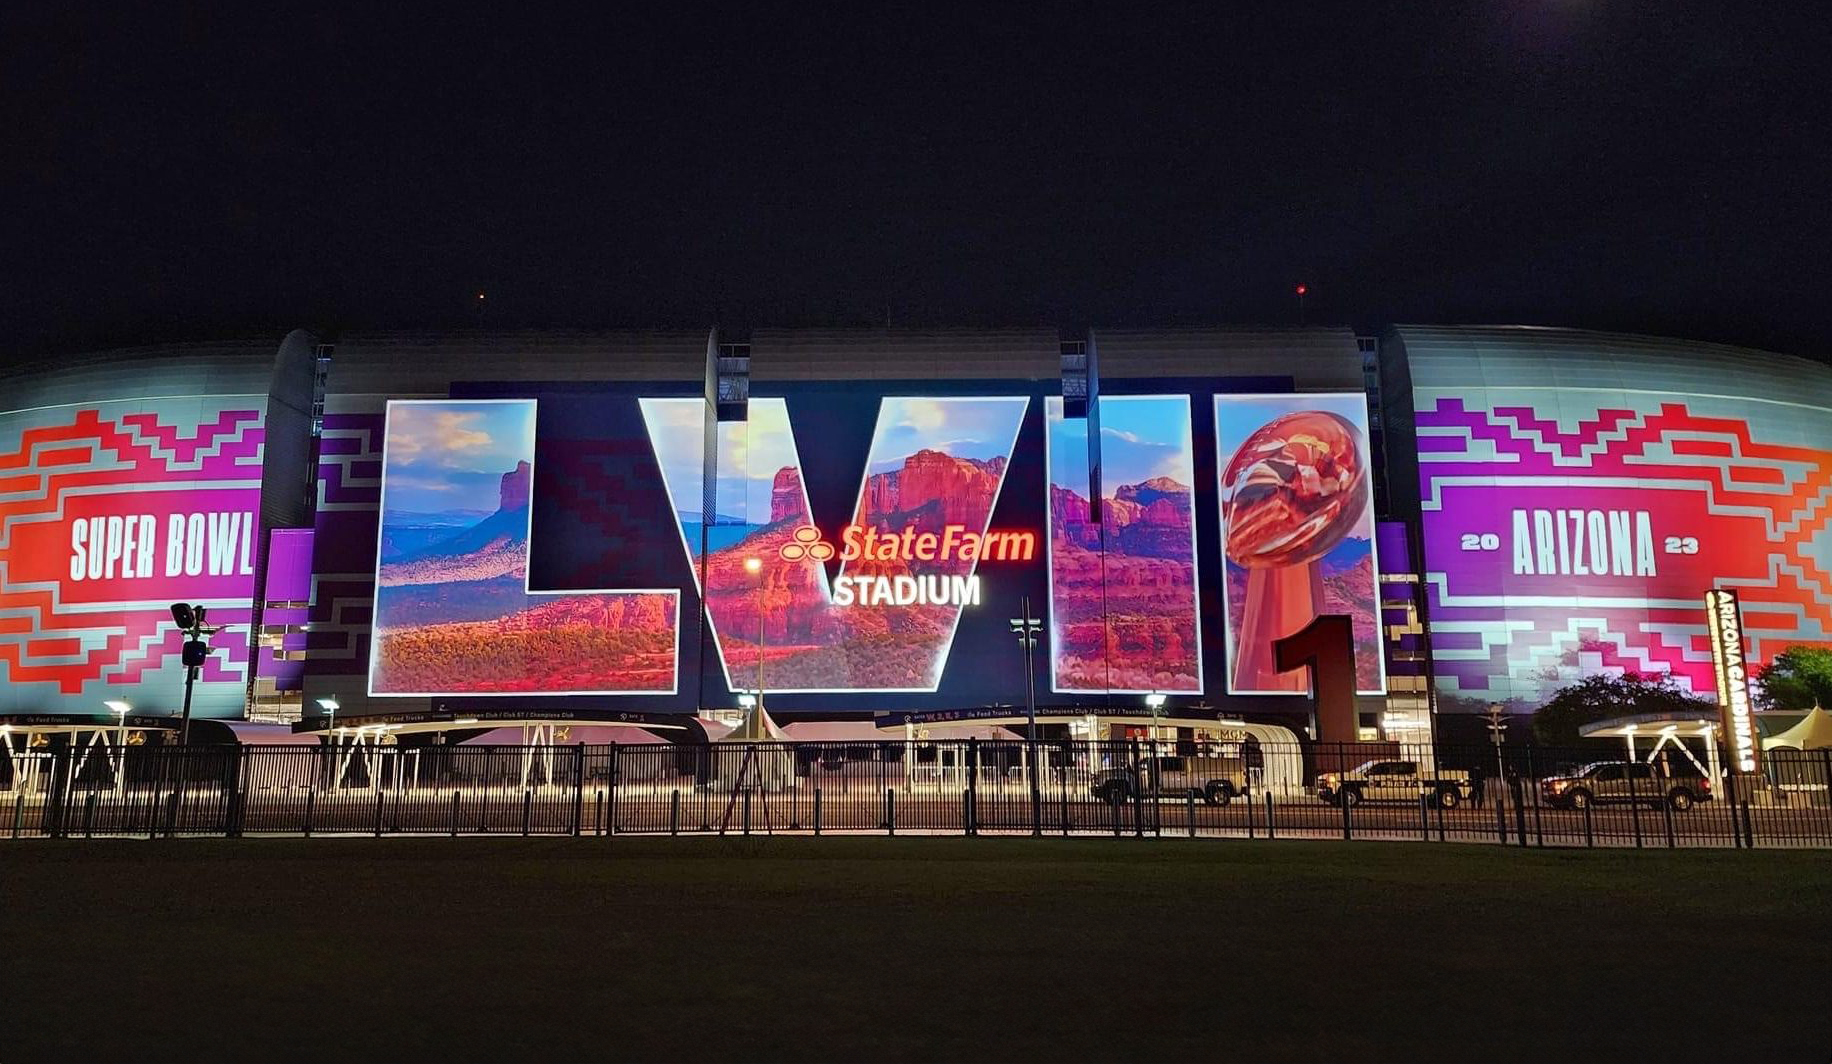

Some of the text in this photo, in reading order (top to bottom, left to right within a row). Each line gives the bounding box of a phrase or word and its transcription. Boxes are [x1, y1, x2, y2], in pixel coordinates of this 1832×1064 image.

[70, 512, 254, 581] SUPER BOWL
[839, 524, 1035, 561] State Farm
[1461, 509, 1699, 577] 20 ARIZONA 23
[833, 574, 981, 606] STADIUM
[1717, 590, 1742, 667] ARIZONA
[1271, 614, 1358, 742] 1
